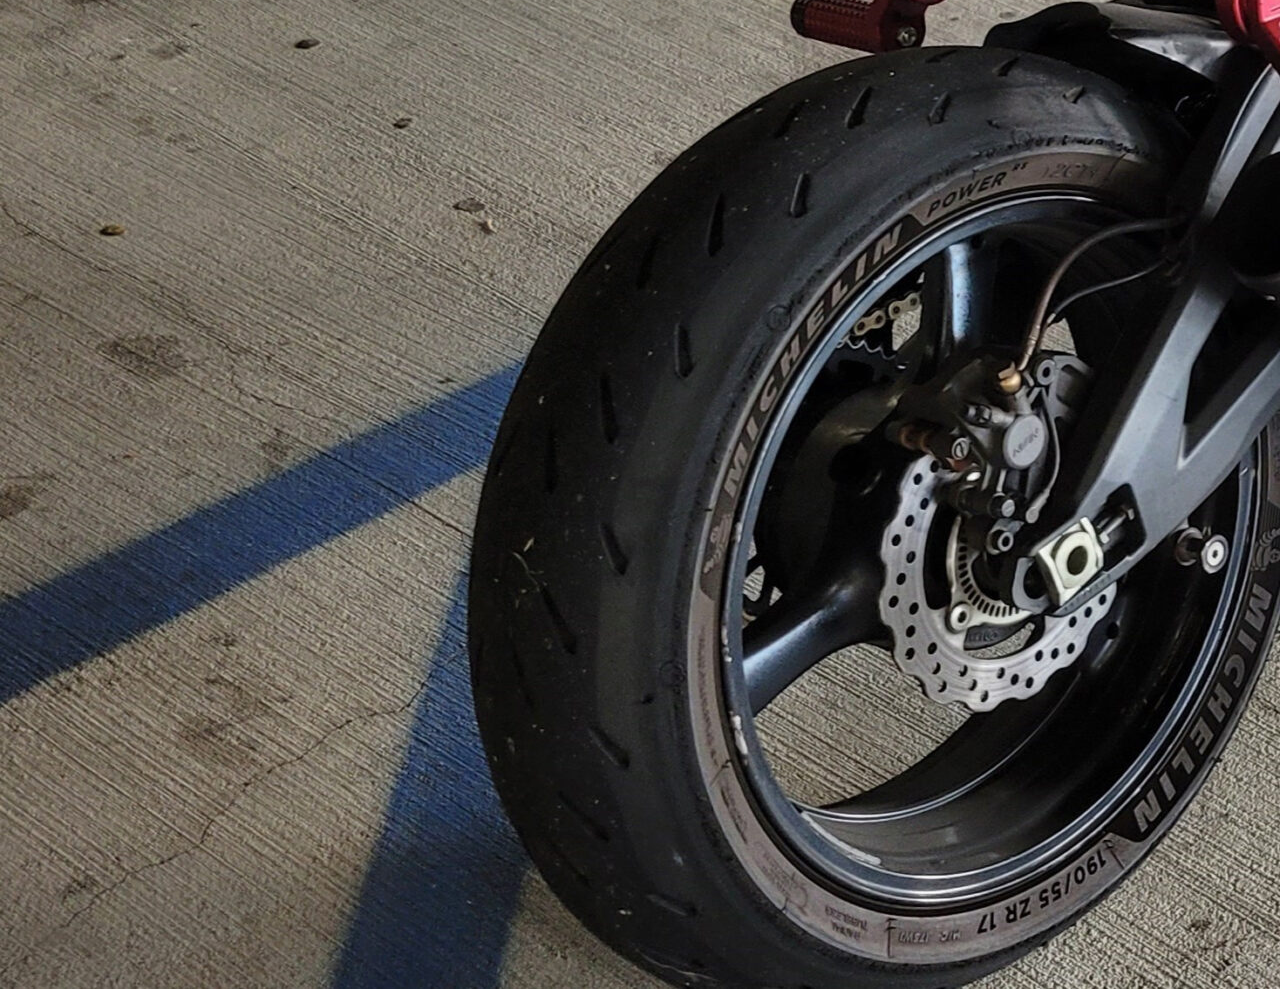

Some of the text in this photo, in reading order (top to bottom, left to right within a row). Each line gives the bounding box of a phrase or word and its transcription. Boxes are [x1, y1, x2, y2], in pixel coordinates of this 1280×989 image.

[722, 223, 904, 499] MICHELIN
[928, 171, 1008, 217] POWER
[1133, 582, 1273, 834] MICHELIN
[1039, 853, 1107, 909] 190/55
[976, 913, 998, 935] 17
[1005, 898, 1032, 925] ZR
